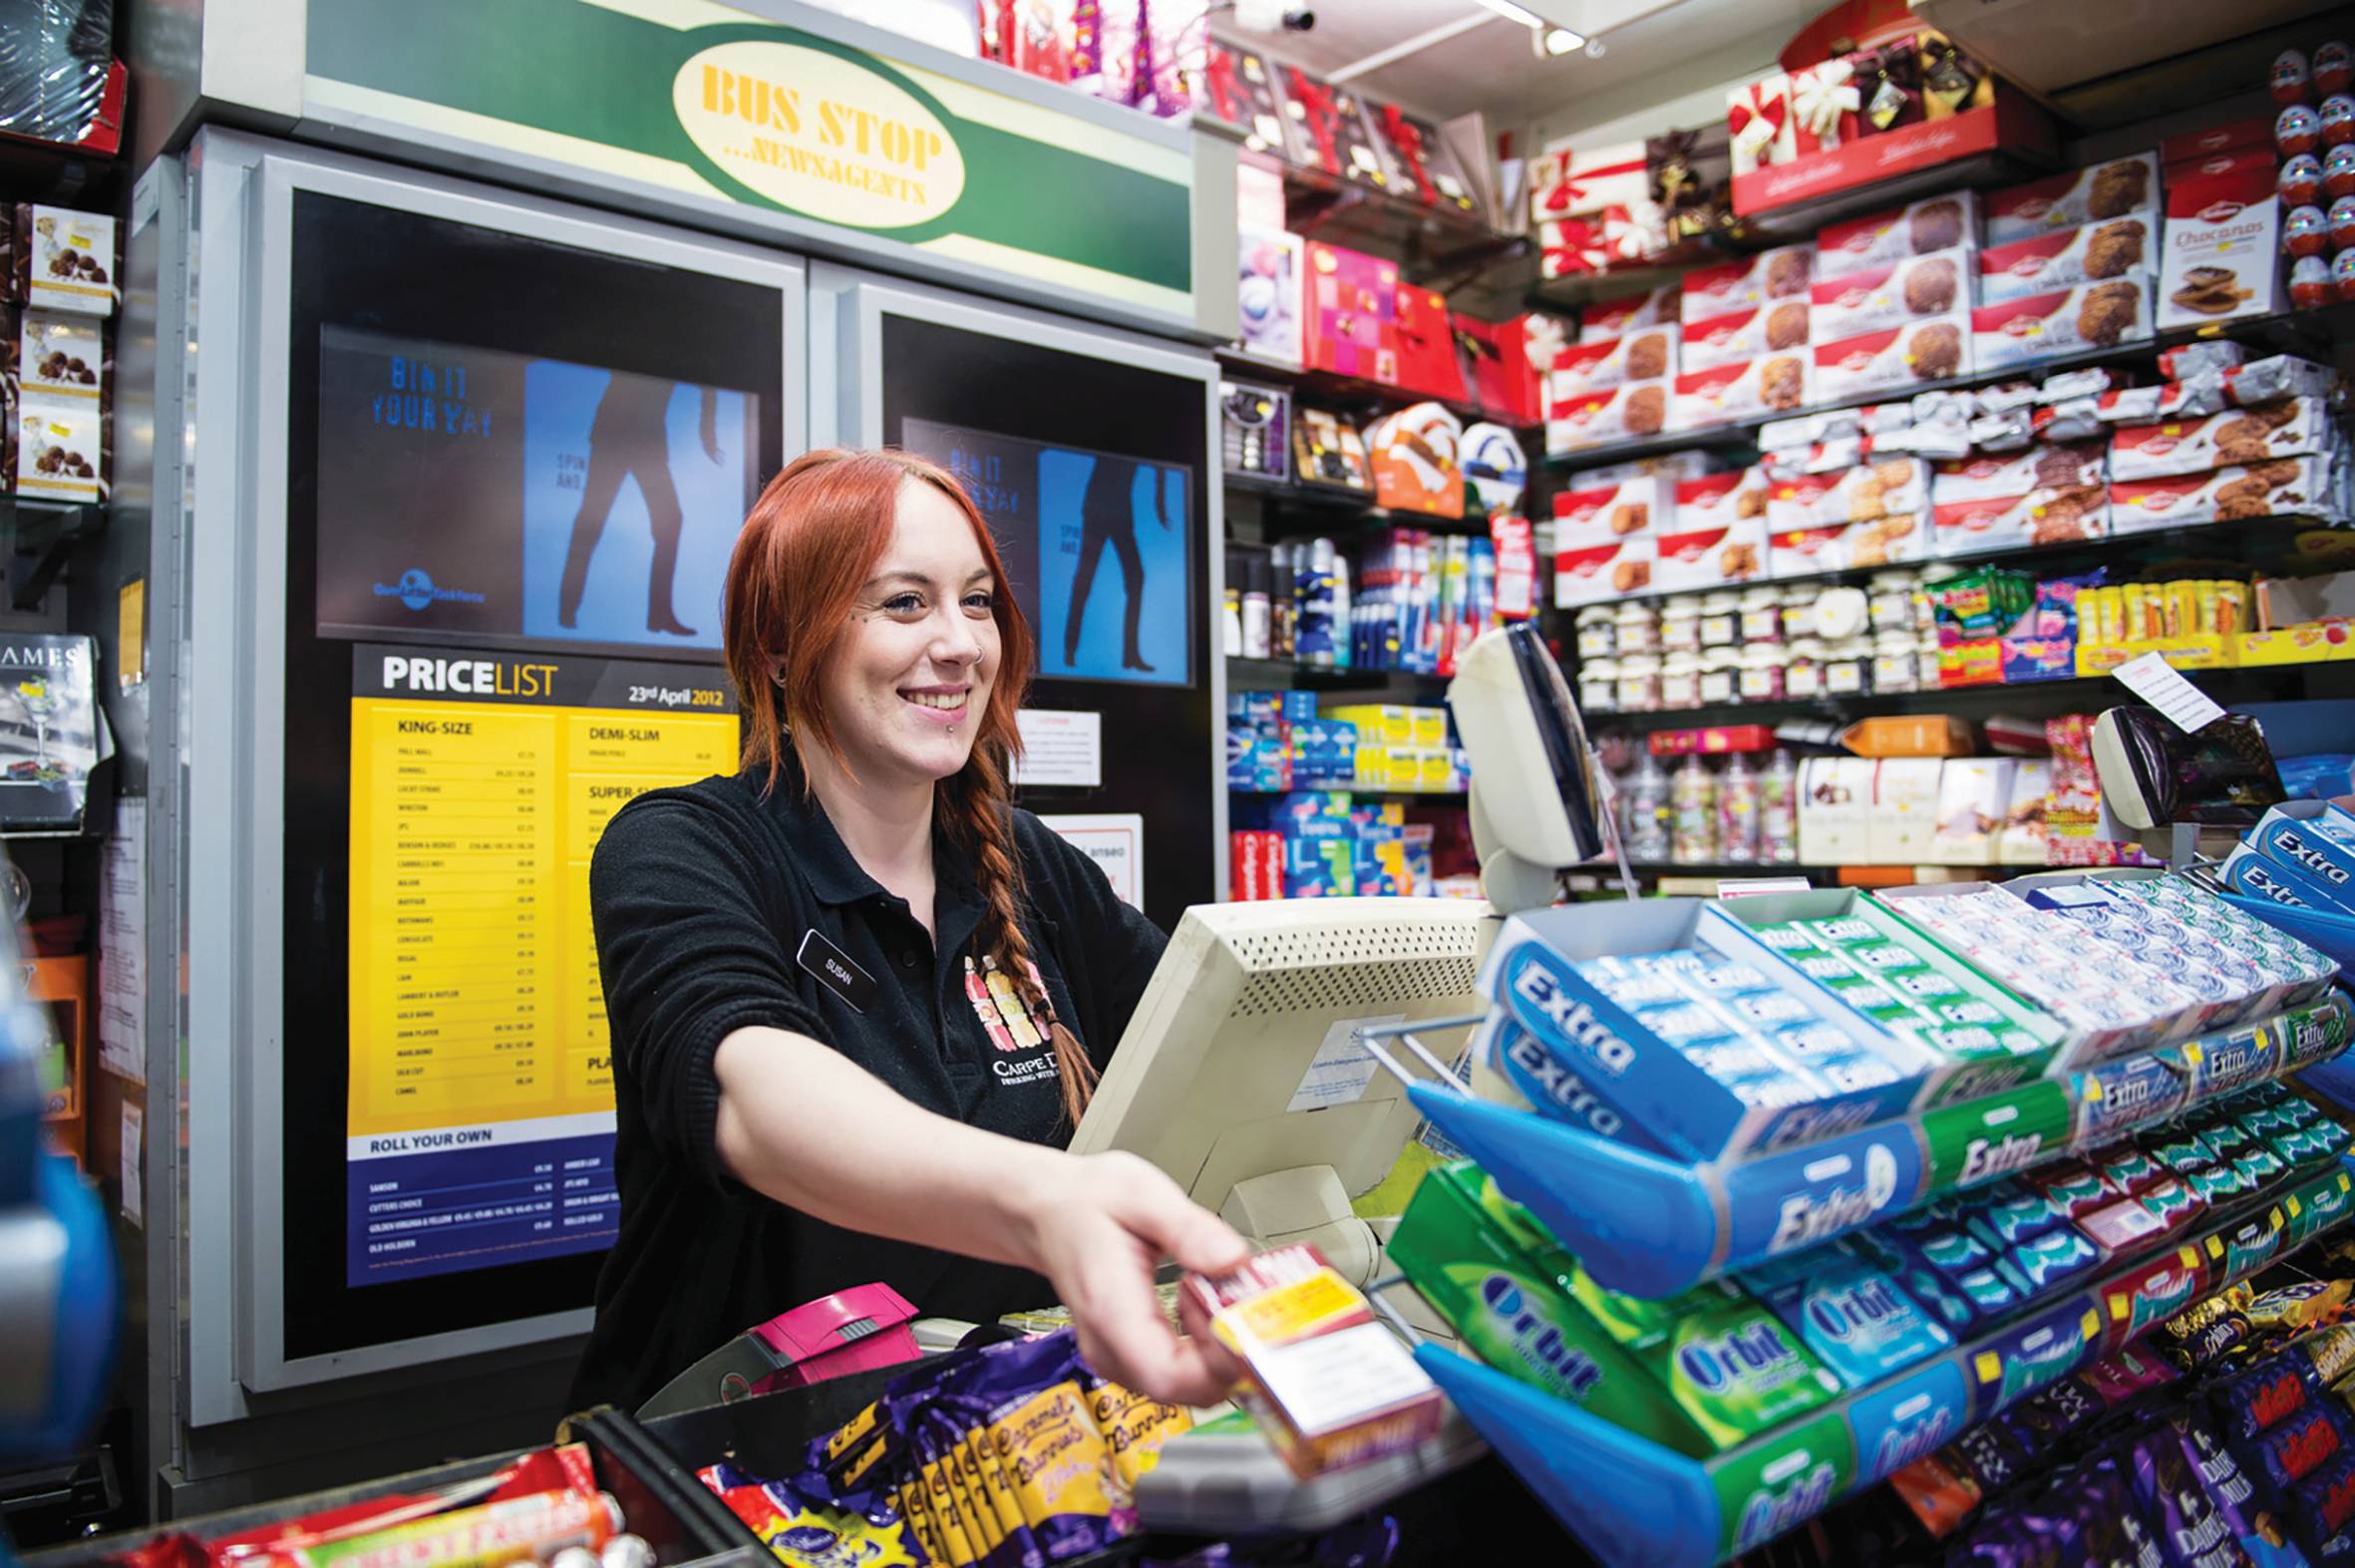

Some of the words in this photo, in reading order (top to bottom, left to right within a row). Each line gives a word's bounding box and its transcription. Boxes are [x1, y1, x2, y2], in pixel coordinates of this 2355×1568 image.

[702, 63, 801, 136] BUS
[819, 99, 942, 172] STOP
[383, 656, 558, 697] PRICELIST
[628, 686, 658, 702] 23rd
[658, 688, 691, 707] April
[691, 690, 724, 707] 2012
[398, 721, 474, 736] KING-SIZE
[589, 728, 660, 742] DEMI-SLIM
[2273, 829, 2350, 885] Extra
[2241, 865, 2314, 910] Extr
[826, 958, 853, 985] SUSAN
[1513, 959, 1636, 1077] Extra
[1507, 1031, 1622, 1136] Extra
[2209, 1047, 2245, 1078] Extra
[2104, 1077, 2149, 1112] Extra
[370, 1138, 409, 1153] ROLL
[412, 1132, 454, 1148] YOUR
[456, 1128, 493, 1144] OWN
[1481, 1272, 1602, 1395] Orbit
[1806, 1276, 1911, 1344] Orbit
[1677, 1319, 1800, 1394] Orbit
[997, 1394, 1075, 1457] Caramel
[1105, 1404, 1178, 1453] Bunnies
[1011, 1425, 1085, 1485] Bunnies
